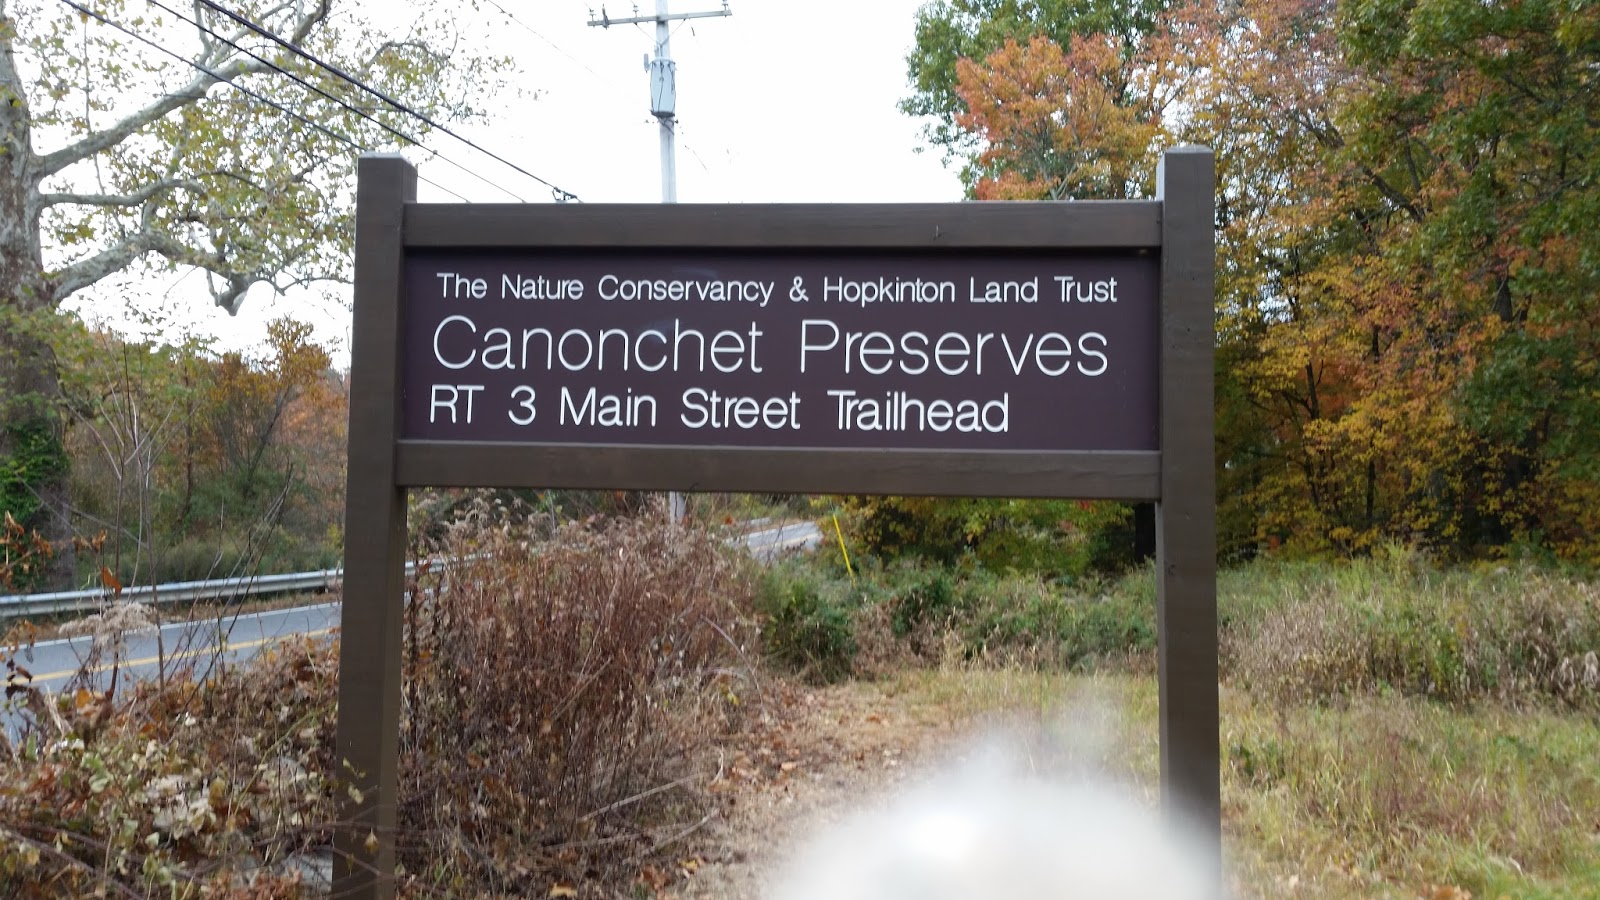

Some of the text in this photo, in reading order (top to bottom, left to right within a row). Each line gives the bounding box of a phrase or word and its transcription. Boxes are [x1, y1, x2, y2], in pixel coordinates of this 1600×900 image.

[436, 272, 1118, 308] The Nature Conservancy & Hopkinton Land Trust
[433, 314, 1108, 377] Canonchet Preserves
[429, 384, 1009, 433] RT 3 Main Street Trailhead
